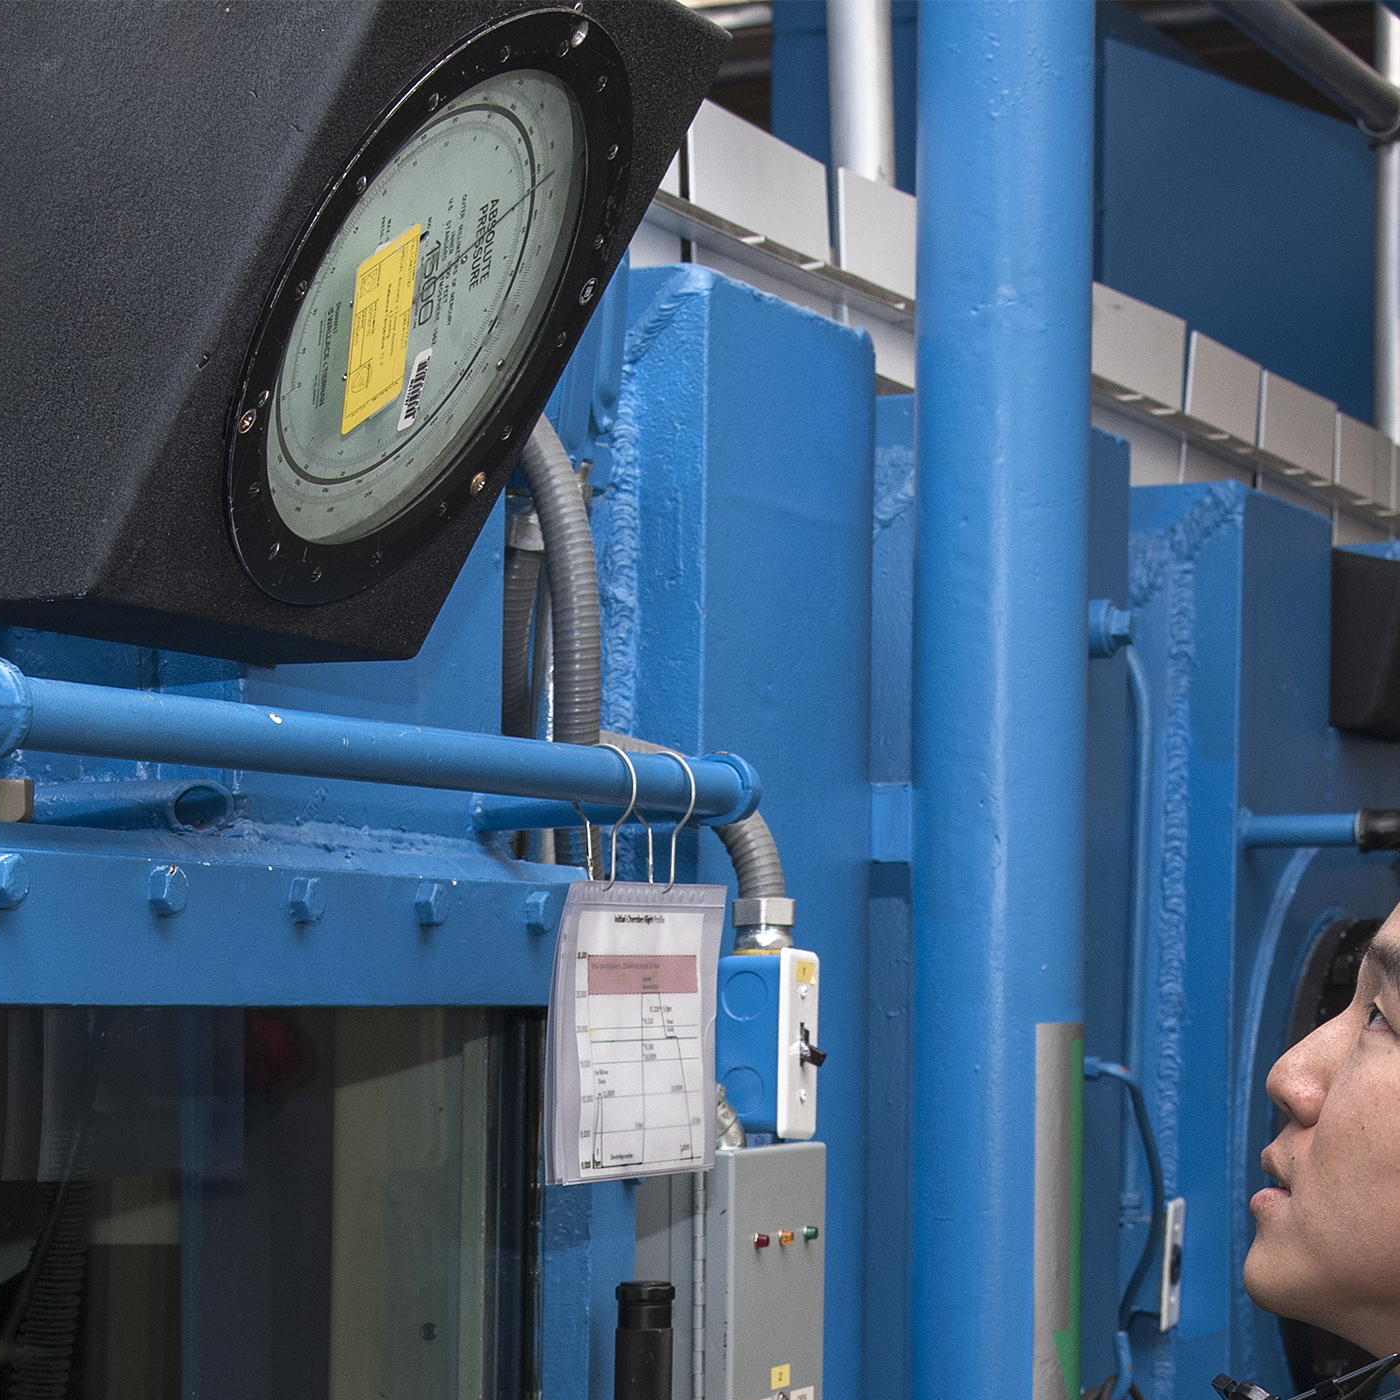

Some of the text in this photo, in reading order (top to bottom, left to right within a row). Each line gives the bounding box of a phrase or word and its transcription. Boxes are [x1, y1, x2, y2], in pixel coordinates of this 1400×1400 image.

[459, 192, 467, 220] OUTER
[441, 218, 451, 263] STANDARD
[452, 222, 463, 276] MILLIMETERS
[469, 203, 489, 292] PRESSURE
[481, 198, 500, 283] ABSOLUTE
[418, 240, 442, 326] 1500
[322, 314, 332, 362] WALLACE
[318, 365, 328, 407] TIERNAN
